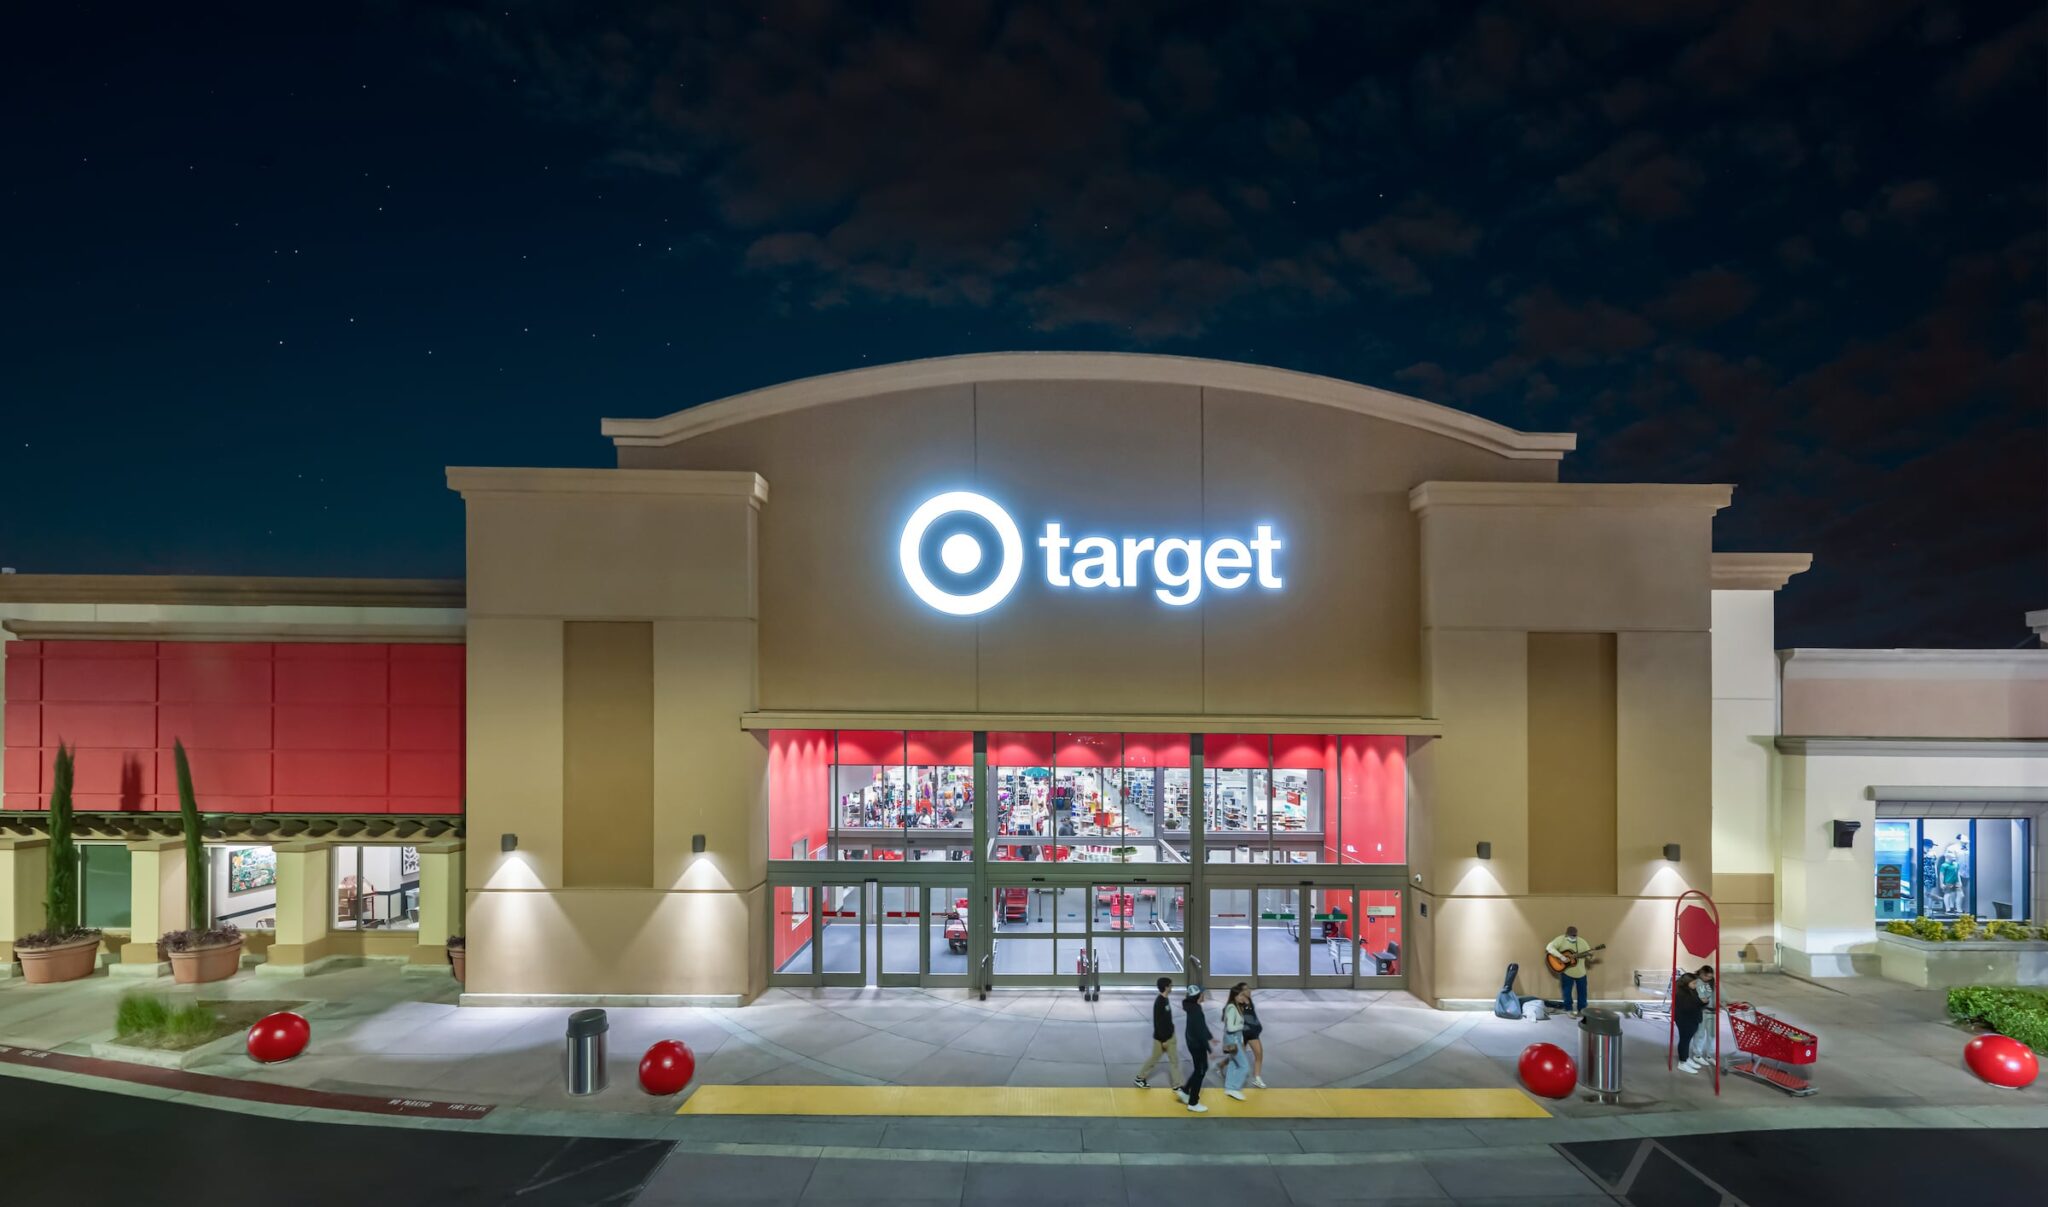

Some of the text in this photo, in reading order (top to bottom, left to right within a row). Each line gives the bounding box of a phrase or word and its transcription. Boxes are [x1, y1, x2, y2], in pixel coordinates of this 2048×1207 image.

[1039, 523, 1282, 605] target
[401, 1099, 433, 1108] PARKING
[448, 1104, 466, 1112] FIRE
